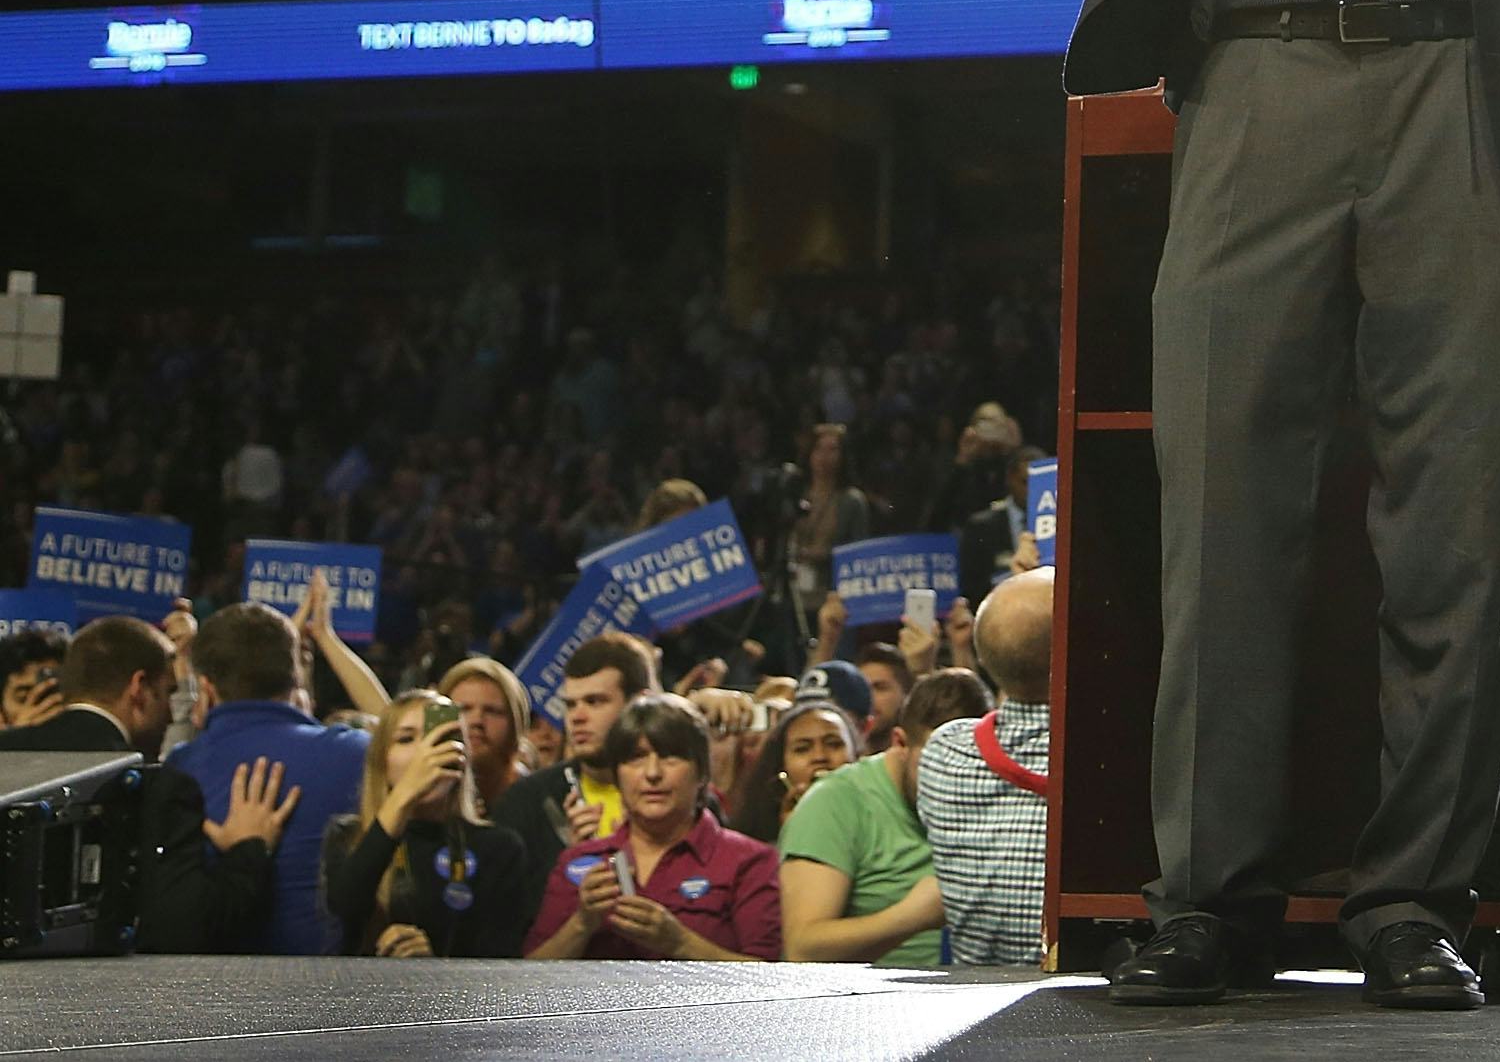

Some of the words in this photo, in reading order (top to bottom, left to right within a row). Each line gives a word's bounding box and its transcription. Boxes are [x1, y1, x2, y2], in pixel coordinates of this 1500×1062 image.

[358, 23, 413, 50] TEXT
[491, 18, 527, 46] TO
[703, 525, 736, 549] TO
[40, 532, 58, 554] A
[61, 534, 151, 567] FUTURE
[157, 546, 186, 572] TO
[711, 544, 745, 573] IN
[852, 552, 925, 574] FUTURE
[931, 553, 957, 570] TO
[36, 554, 148, 593] BELIEVE
[154, 571, 184, 596] IN
[251, 560, 265, 579] A
[348, 567, 377, 588] TO
[837, 570, 927, 599] BELIEVE
[247, 580, 341, 609] BELIEE
[346, 589, 375, 611] IN
[596, 581, 622, 609] TO
